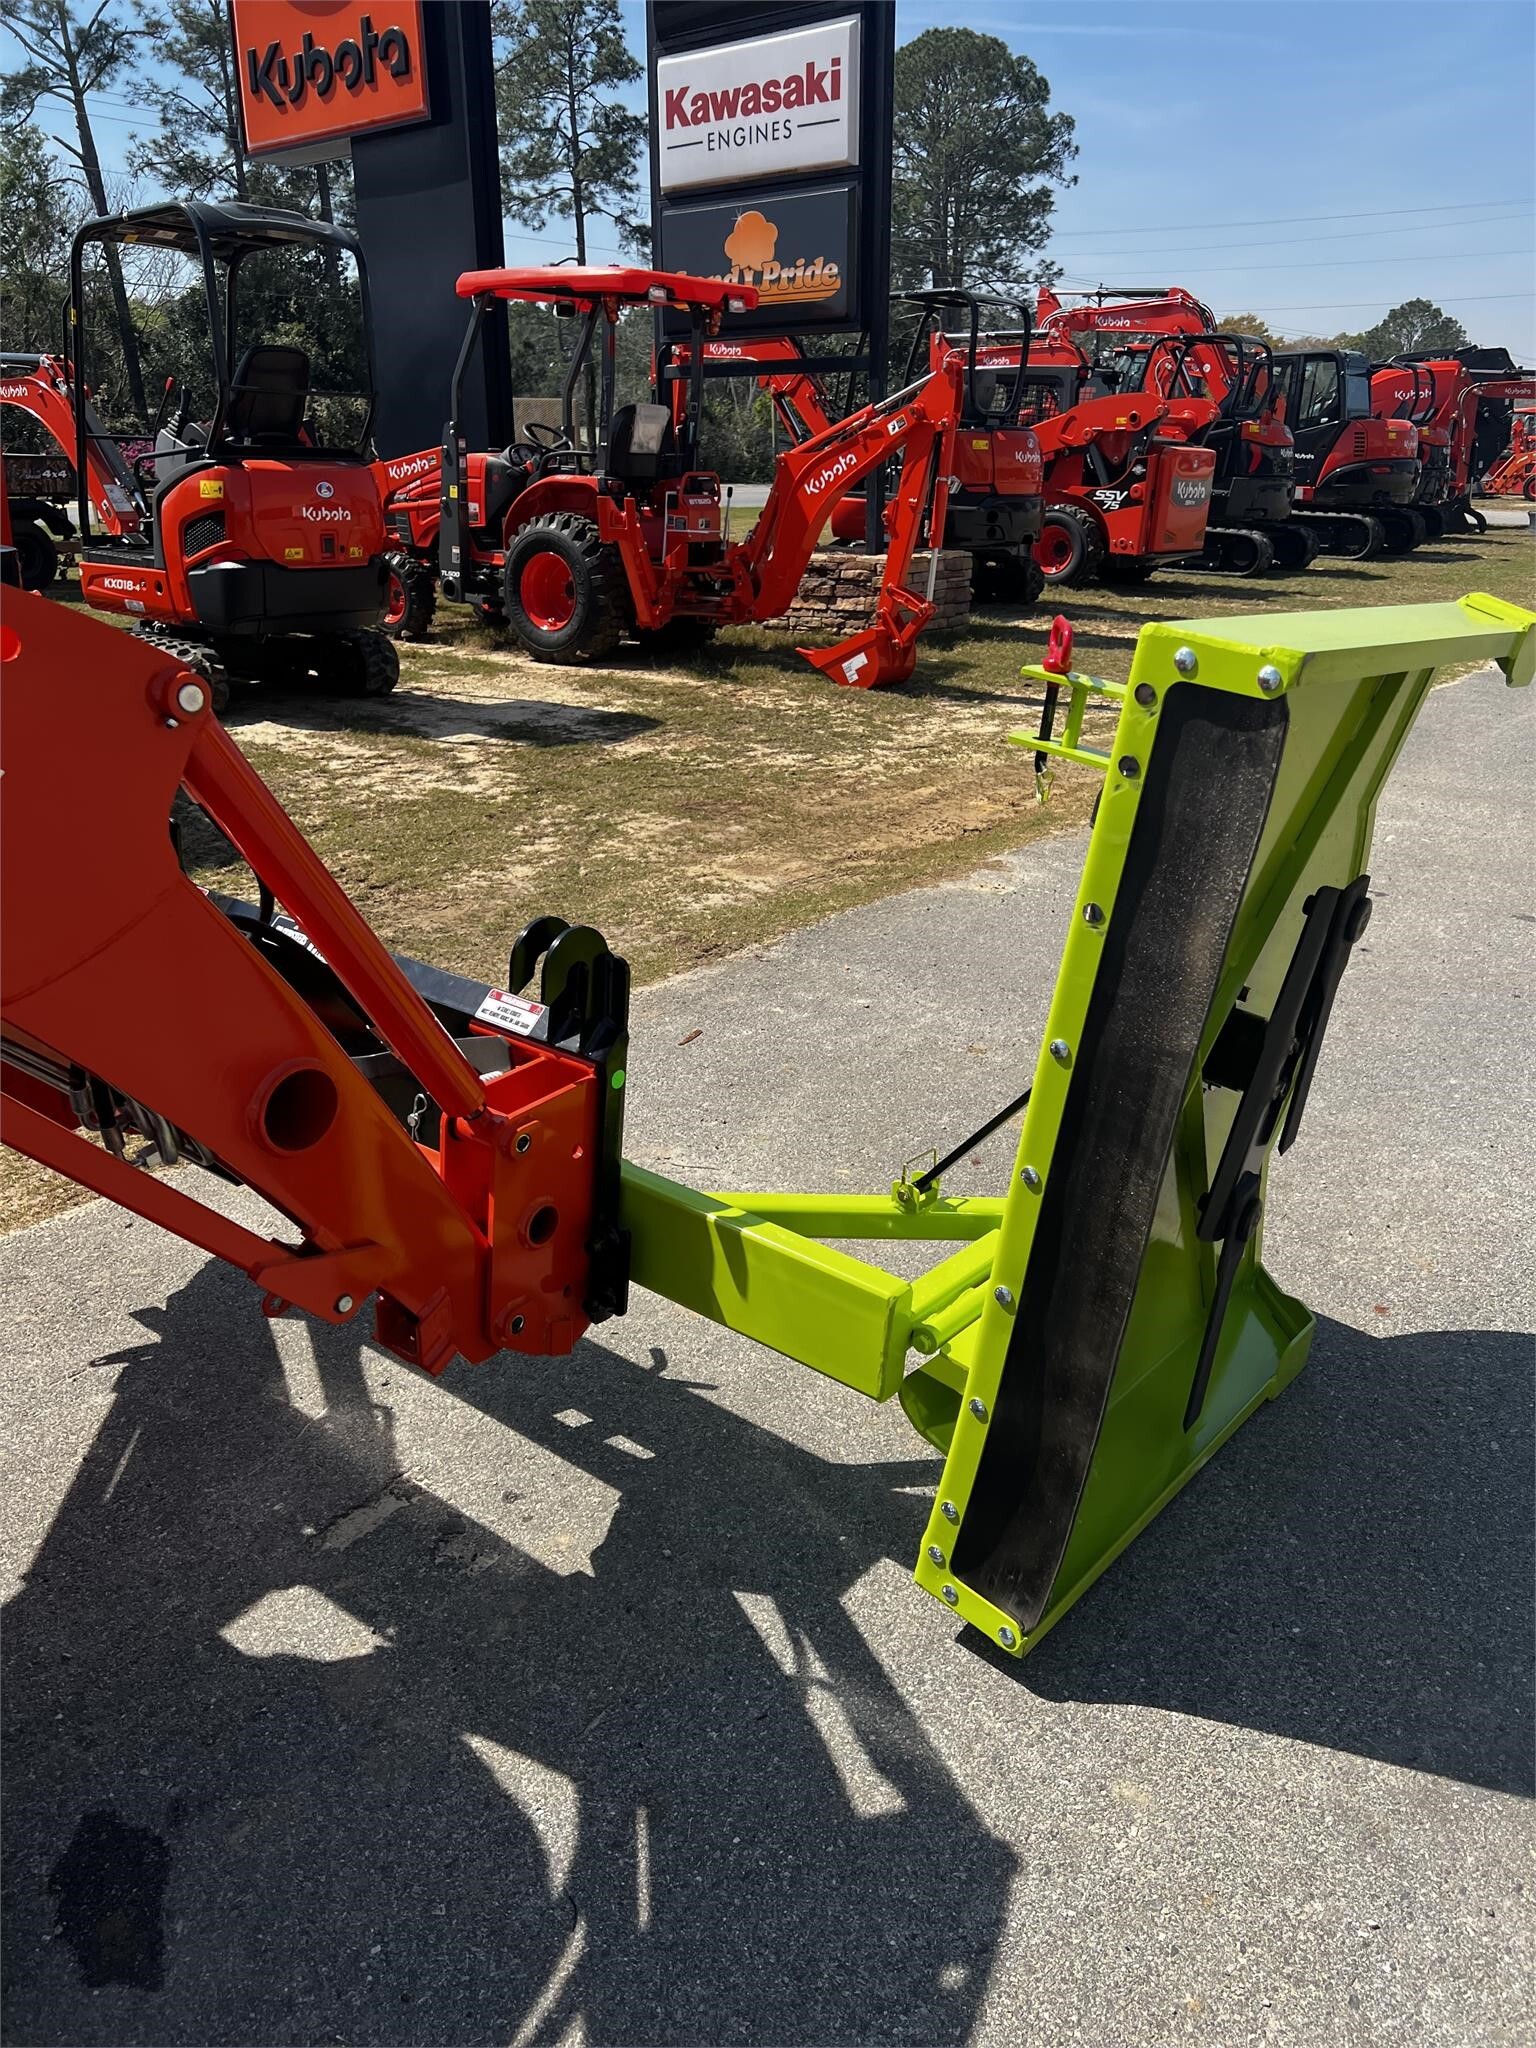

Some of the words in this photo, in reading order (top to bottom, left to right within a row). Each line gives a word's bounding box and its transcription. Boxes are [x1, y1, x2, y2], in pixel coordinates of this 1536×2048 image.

[247, 14, 411, 106] Kubota
[665, 57, 841, 130] Kawasaki
[707, 119, 792, 151] ENGINES
[760, 257, 839, 292] Pride
[1095, 315, 1130, 327] Kubota
[710, 343, 742, 356] Kubota
[42, 469, 67, 479] 4x4
[388, 457, 429, 480] Kubota
[804, 453, 857, 495] Kubota
[1093, 489, 1128, 501] SSV
[1177, 480, 1206, 500] Kubota
[302, 506, 352, 521] Kubota
[1102, 500, 1120, 510] 75
[104, 577, 141, 592] KX018-4
